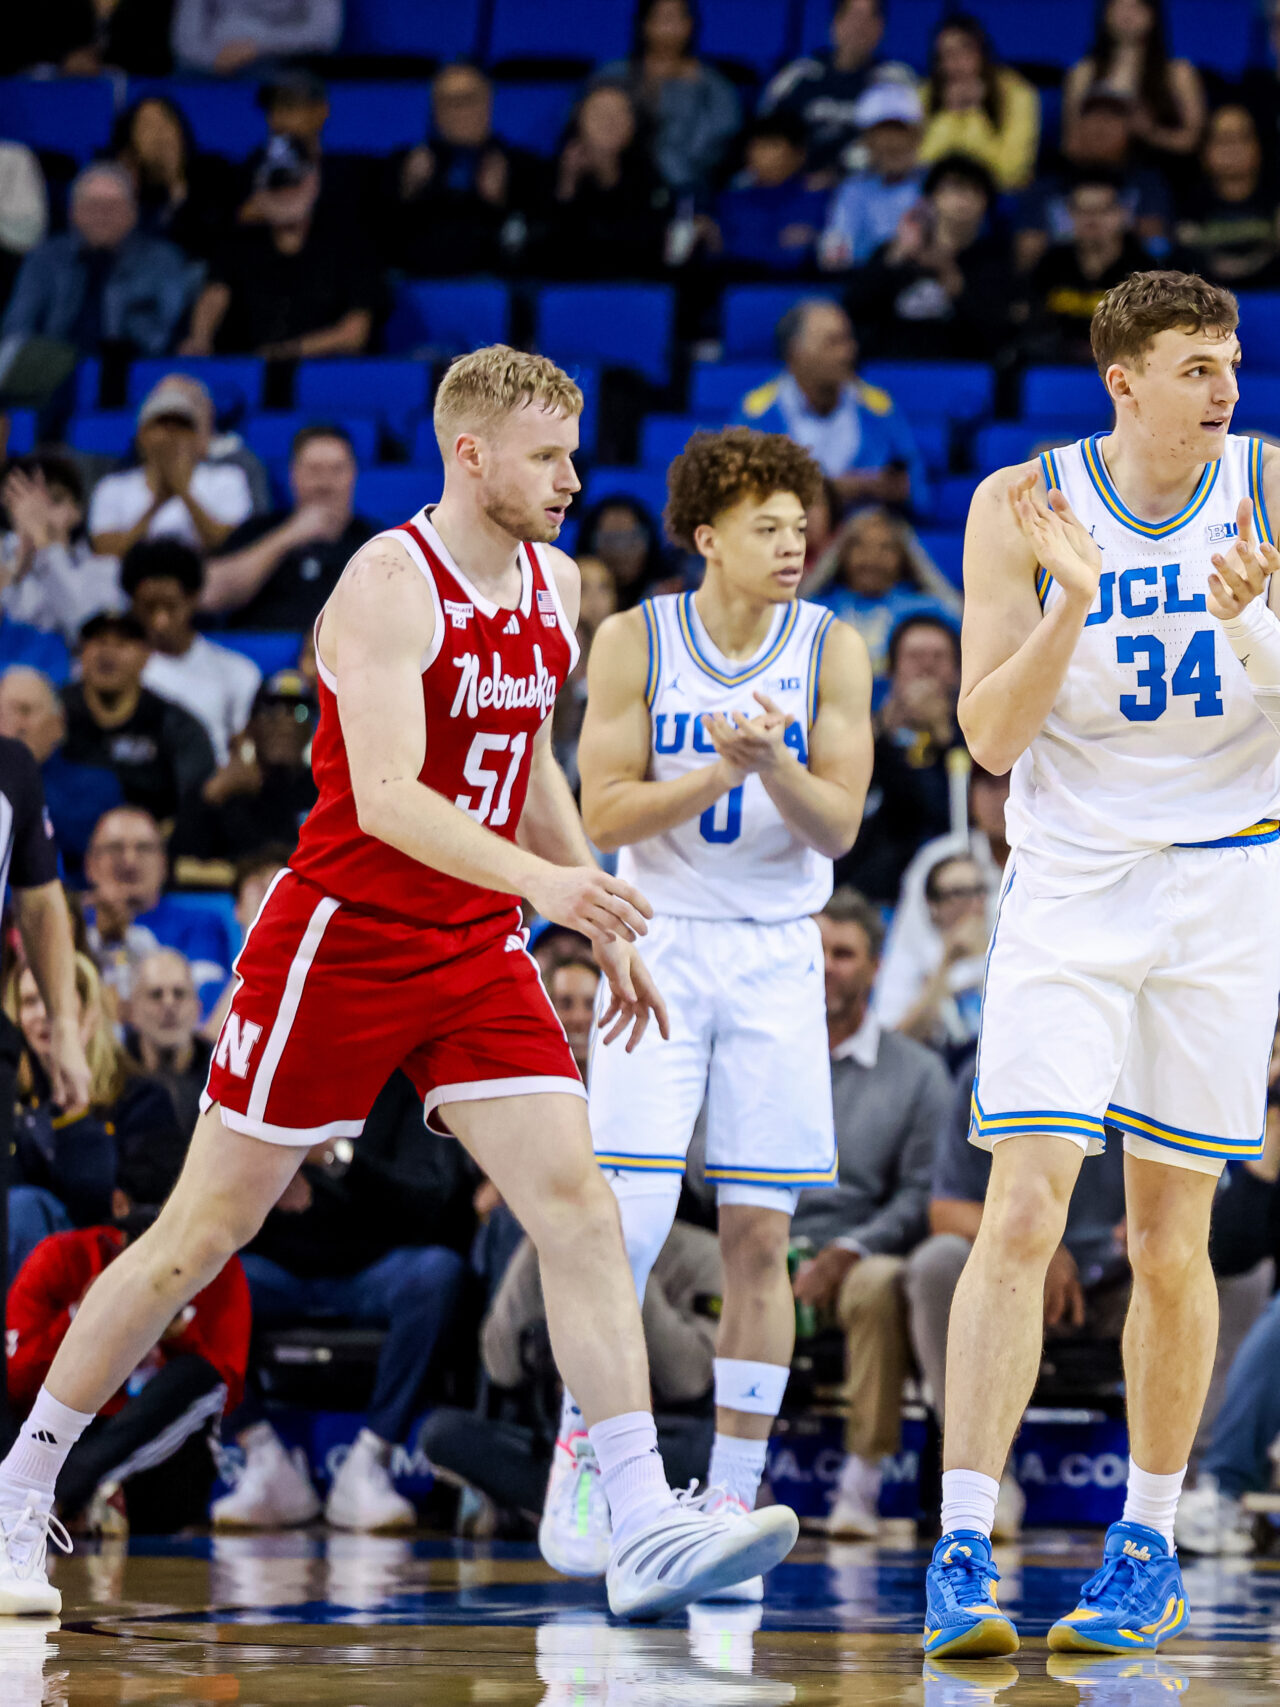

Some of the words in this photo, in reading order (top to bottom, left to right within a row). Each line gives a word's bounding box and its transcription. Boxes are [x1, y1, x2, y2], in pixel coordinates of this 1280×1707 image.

[1084, 563, 1207, 627] UCL
[450, 643, 557, 720] Nebraska
[1116, 630, 1224, 722] 34
[655, 713, 808, 765] UCA
[455, 731, 528, 826] 51
[216, 1011, 263, 1079] N
